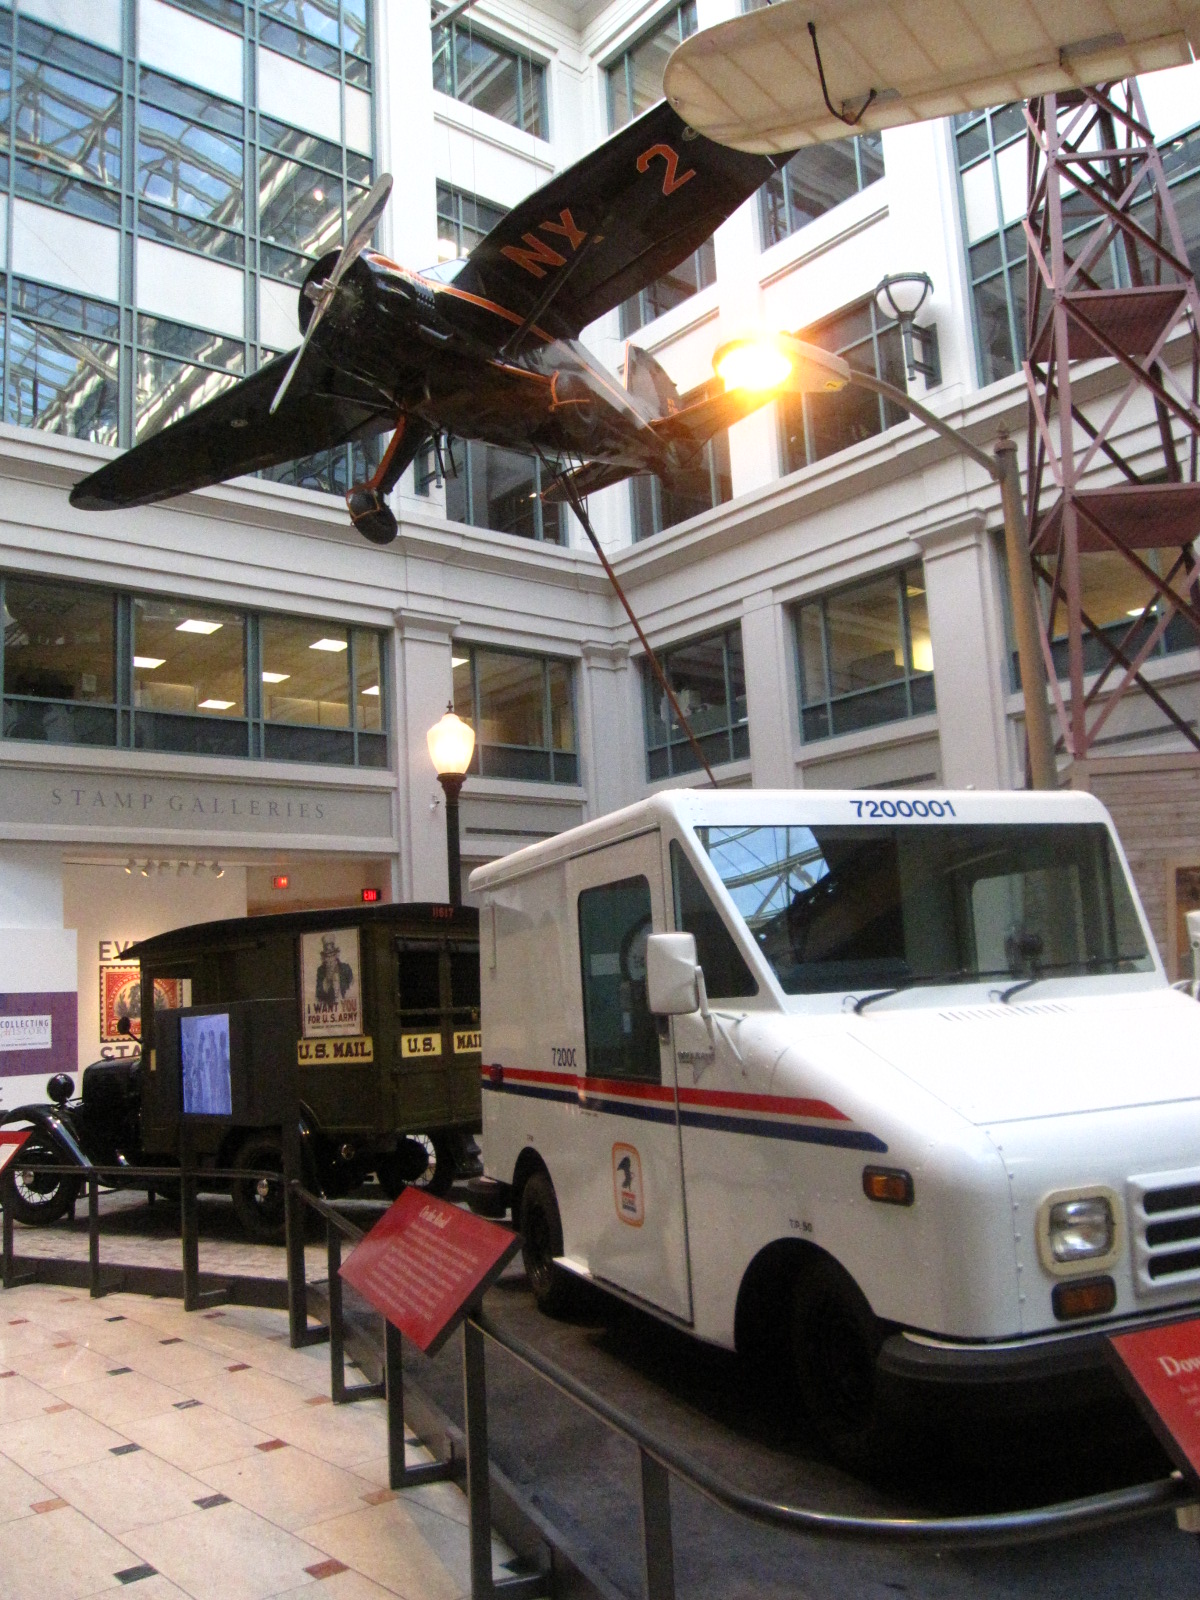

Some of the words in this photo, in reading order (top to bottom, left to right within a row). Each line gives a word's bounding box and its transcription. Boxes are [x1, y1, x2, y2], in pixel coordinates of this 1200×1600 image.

[636, 144, 697, 196] 2
[51, 788, 154, 810] STAMP
[168, 795, 326, 819] GALLERIES
[849, 799, 957, 818] 7200001
[313, 1002, 339, 1014] WANT
[341, 998, 358, 1012] YOU
[0, 1019, 49, 1029] COLLECTING
[307, 1014, 321, 1024] FOR
[338, 1012, 358, 1023] ARMY
[298, 1043, 330, 1060] U.S.
[333, 1041, 372, 1058] MAIL
[407, 1036, 436, 1053] U.S.
